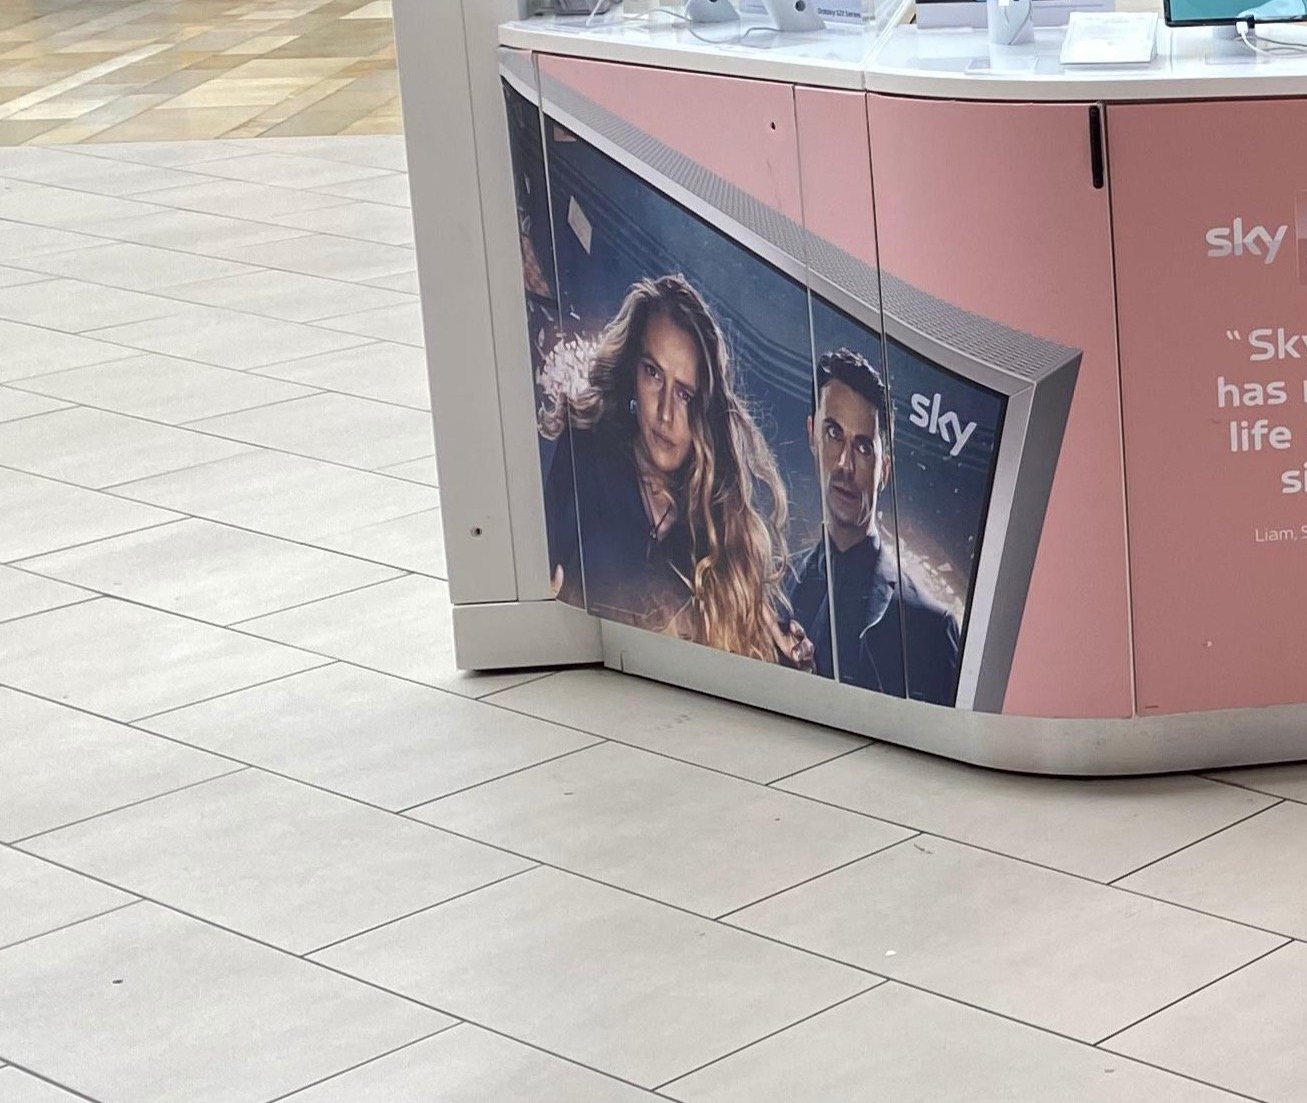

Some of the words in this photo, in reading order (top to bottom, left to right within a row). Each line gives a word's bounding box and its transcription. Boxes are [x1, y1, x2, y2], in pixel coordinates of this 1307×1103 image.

[1206, 217, 1288, 264] sky
[1217, 376, 1287, 408] has
[909, 391, 979, 457] sky
[1229, 419, 1292, 452] life
[1255, 527, 1298, 543] Liam,
